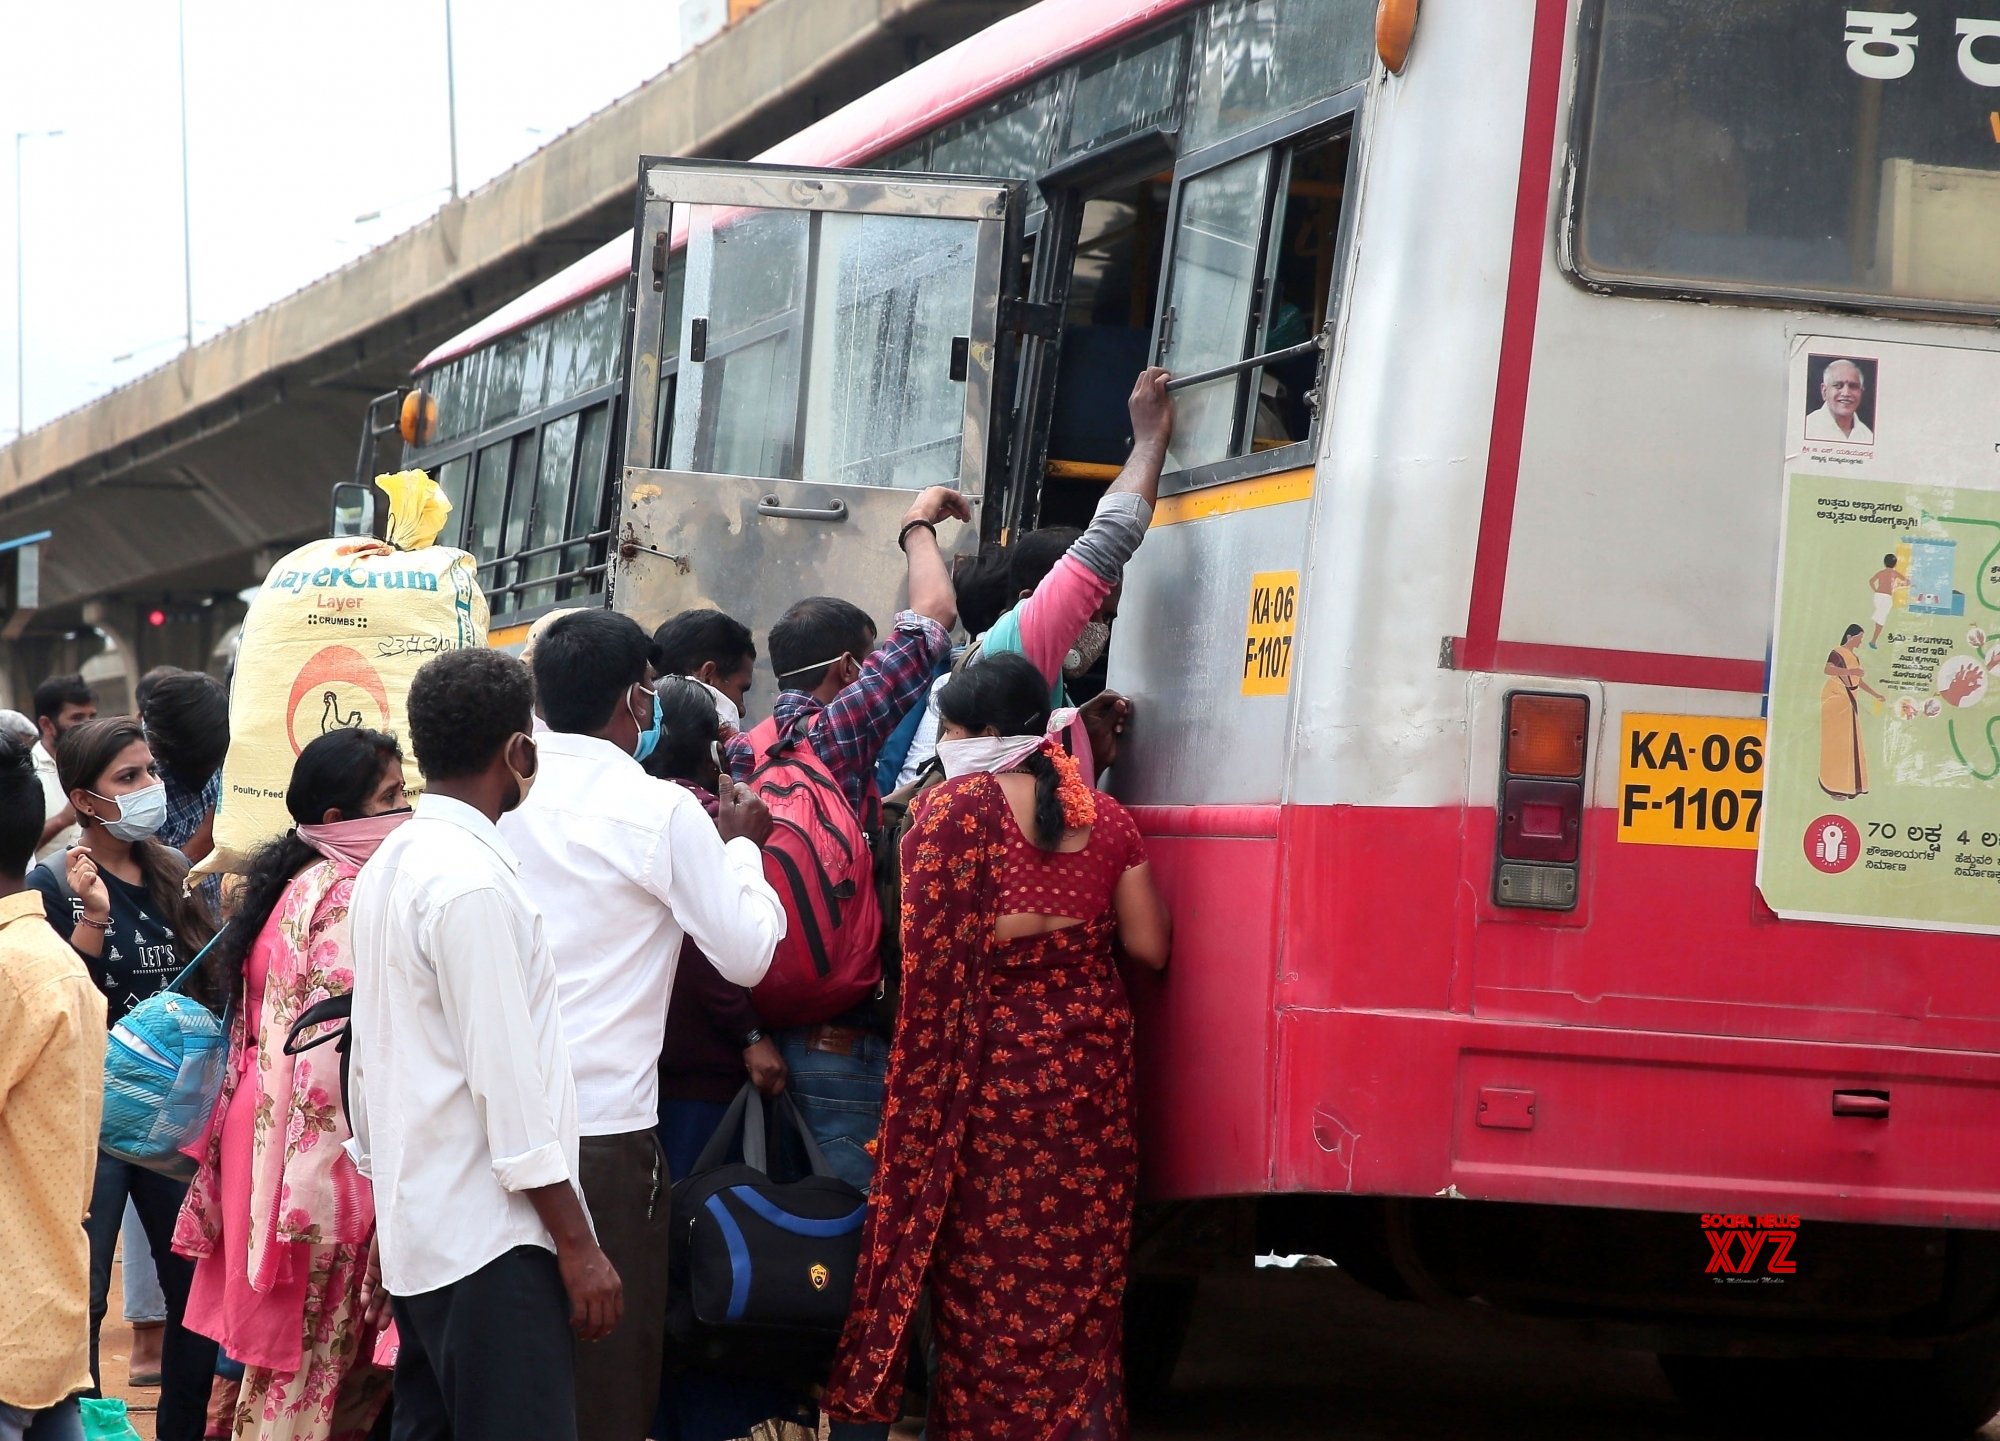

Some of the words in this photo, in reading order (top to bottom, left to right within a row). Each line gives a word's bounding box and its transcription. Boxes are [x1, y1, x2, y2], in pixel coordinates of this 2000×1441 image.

[1817, 498, 1850, 510] ಉತ್ತಮ
[1852, 501, 1903, 515] ಅಭ್ಯಾಸಗಳು
[1817, 510, 1857, 524] ಅತ್ಯುತ್ತಮ
[1859, 514, 1918, 530] ಆರೋಗ್ಯಕ್ಕಾಗಿ!
[317, 593, 364, 612] Layer
[1251, 586, 1295, 625] KA-06
[319, 616, 355, 627] CRUMBS
[1243, 636, 1292, 679] F-1107
[1630, 730, 1763, 774] KA-06
[233, 785, 261, 799] Poultry
[263, 788, 284, 799] Feed
[402, 789, 417, 799] ght
[1623, 784, 1763, 833] F-1107
[1868, 822, 1897, 839] 70
[1907, 824, 1943, 852] ಲಕ್ಷ
[1956, 830, 1971, 845] 4
[1981, 832, 2000, 847] ಲ
[1866, 845, 1936, 861] ಶೌಚಾಲಯಗಳ
[1865, 860, 1907, 872] ನಿರ್ಮಾಣ
[68, 897, 85, 922] ari
[138, 944, 176, 968] LET'S
